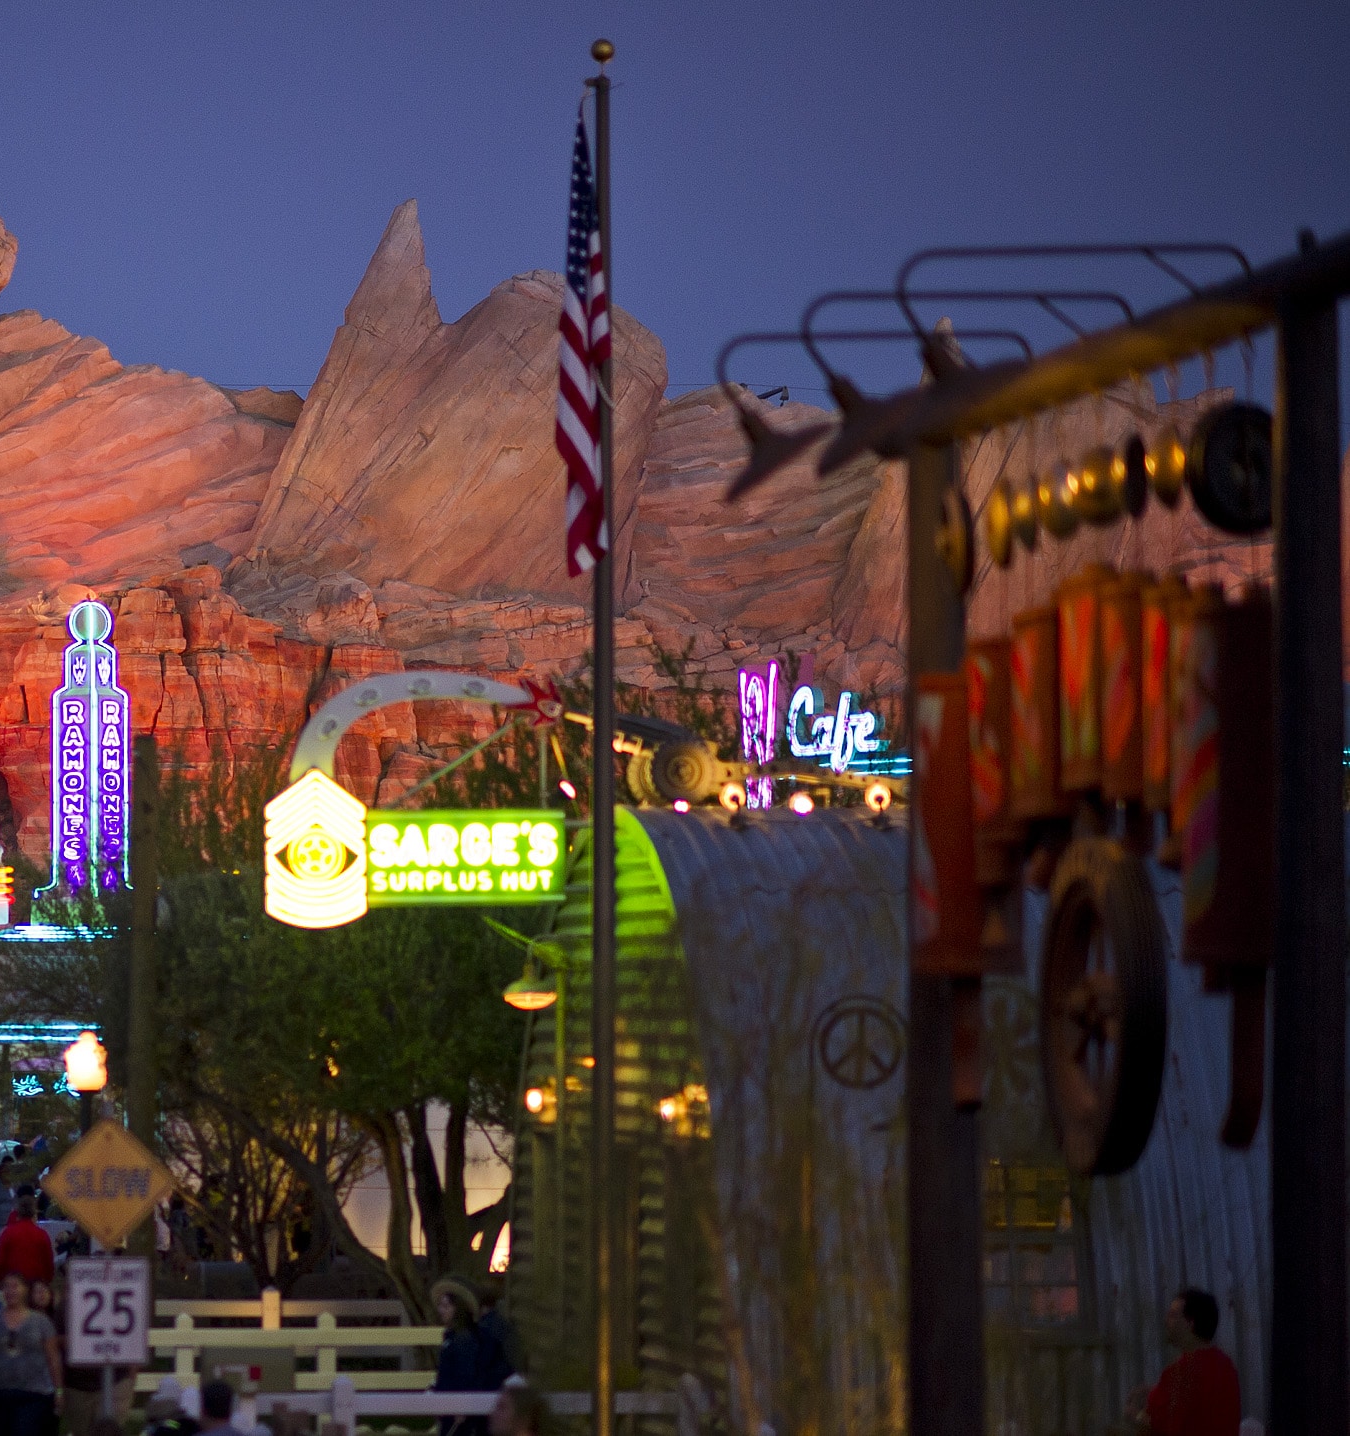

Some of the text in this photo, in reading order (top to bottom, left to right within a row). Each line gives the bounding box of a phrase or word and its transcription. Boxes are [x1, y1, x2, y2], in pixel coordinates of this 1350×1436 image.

[786, 684, 881, 773] Cafe
[368, 820, 559, 869] SARGE'S
[370, 869, 554, 893] SURPLUS HUT
[65, 1165, 151, 1199] SLOW
[82, 1288, 136, 1337] 25
